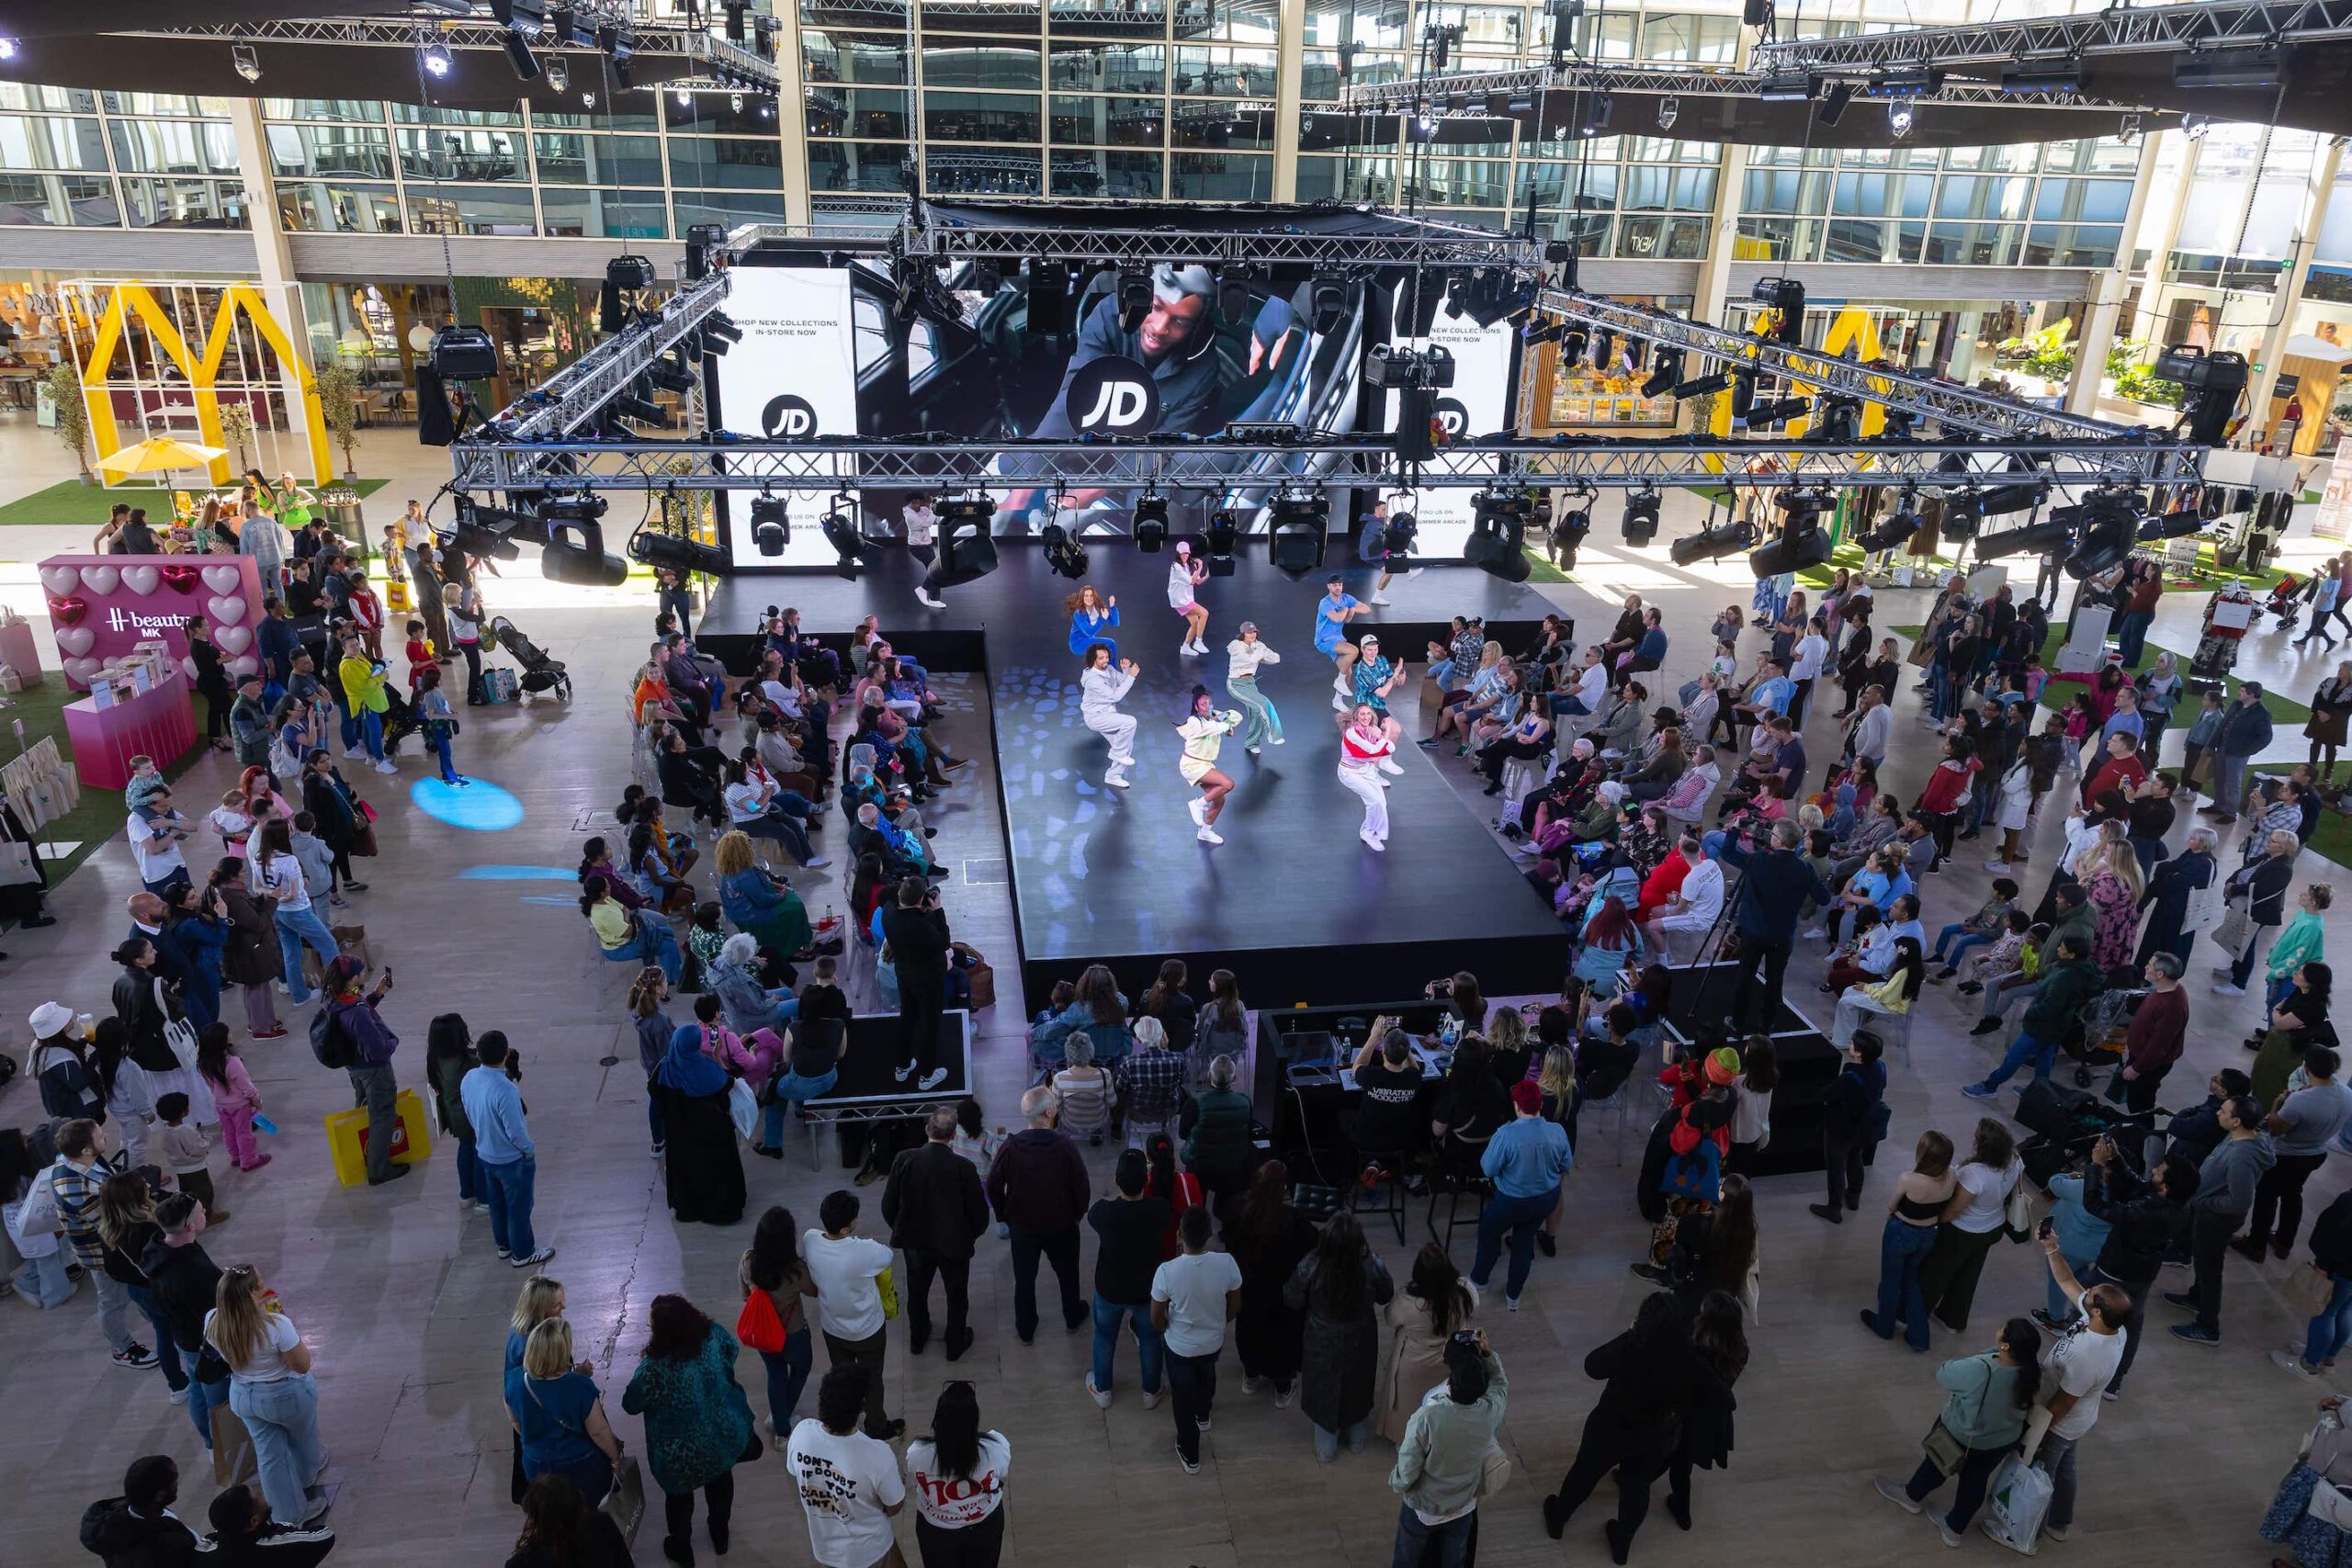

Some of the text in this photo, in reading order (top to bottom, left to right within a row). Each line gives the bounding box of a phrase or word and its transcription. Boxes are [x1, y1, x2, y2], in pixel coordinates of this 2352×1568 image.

[1082, 381, 1148, 427] JD
[771, 409, 810, 435] JD
[129, 610, 191, 631] beauty
[141, 628, 162, 637] MK
[802, 1470, 813, 1479] IF
[815, 1467, 856, 1489] DOUBT
[825, 1480, 856, 1499] YOU
